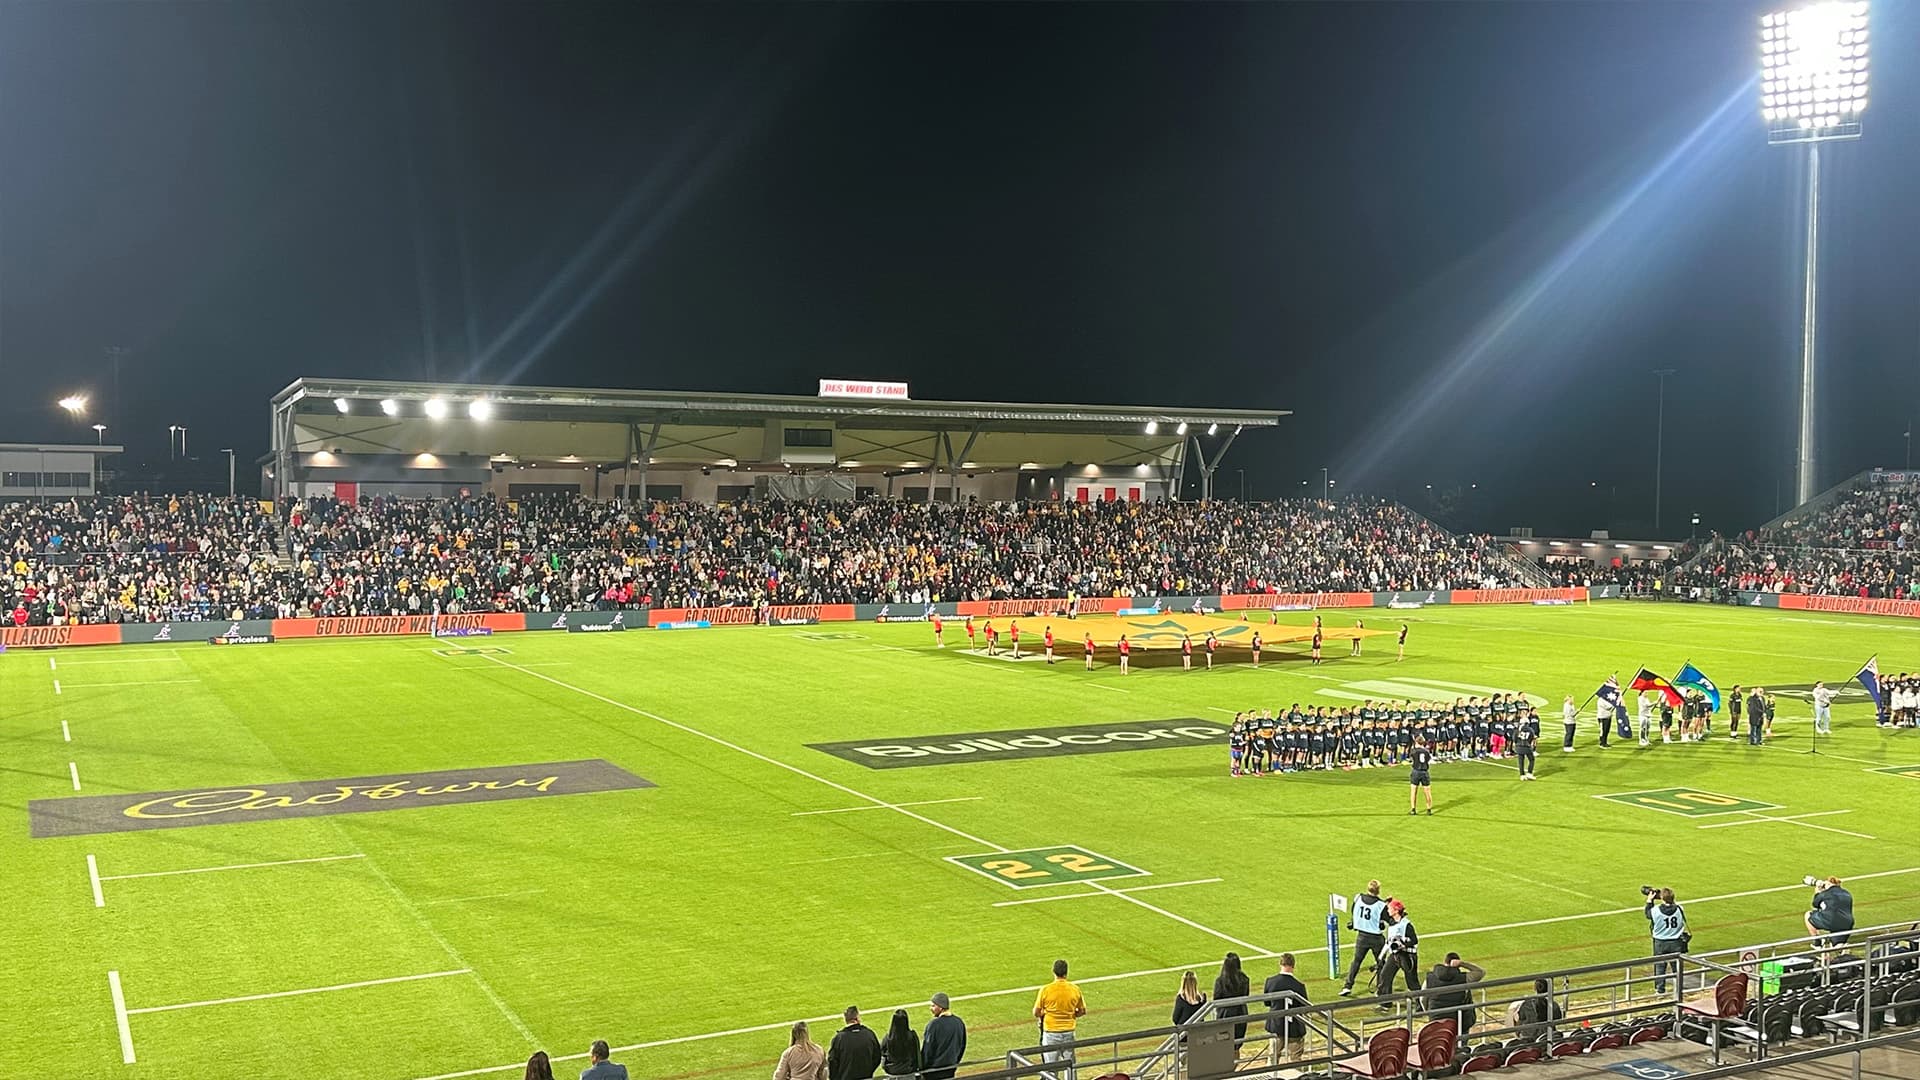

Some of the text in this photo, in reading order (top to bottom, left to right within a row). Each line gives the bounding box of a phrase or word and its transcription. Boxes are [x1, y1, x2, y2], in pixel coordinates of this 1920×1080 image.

[876, 385, 905, 395] STAND
[1806, 597, 1816, 609] GO
[1818, 597, 1863, 611] BUILDCORP
[685, 609, 699, 622] GO
[316, 619, 333, 635] GO
[337, 617, 406, 634] BUILDCORP
[0, 627, 73, 646] LLAROOS!
[229, 635, 268, 645] priceless
[853, 725, 1226, 758] Buildcorp
[123, 776, 560, 819] Cadbury
[1637, 792, 1742, 811] 10
[981, 853, 1116, 880] 22
[1360, 906, 1372, 921] 13
[1663, 916, 1678, 929] 18
